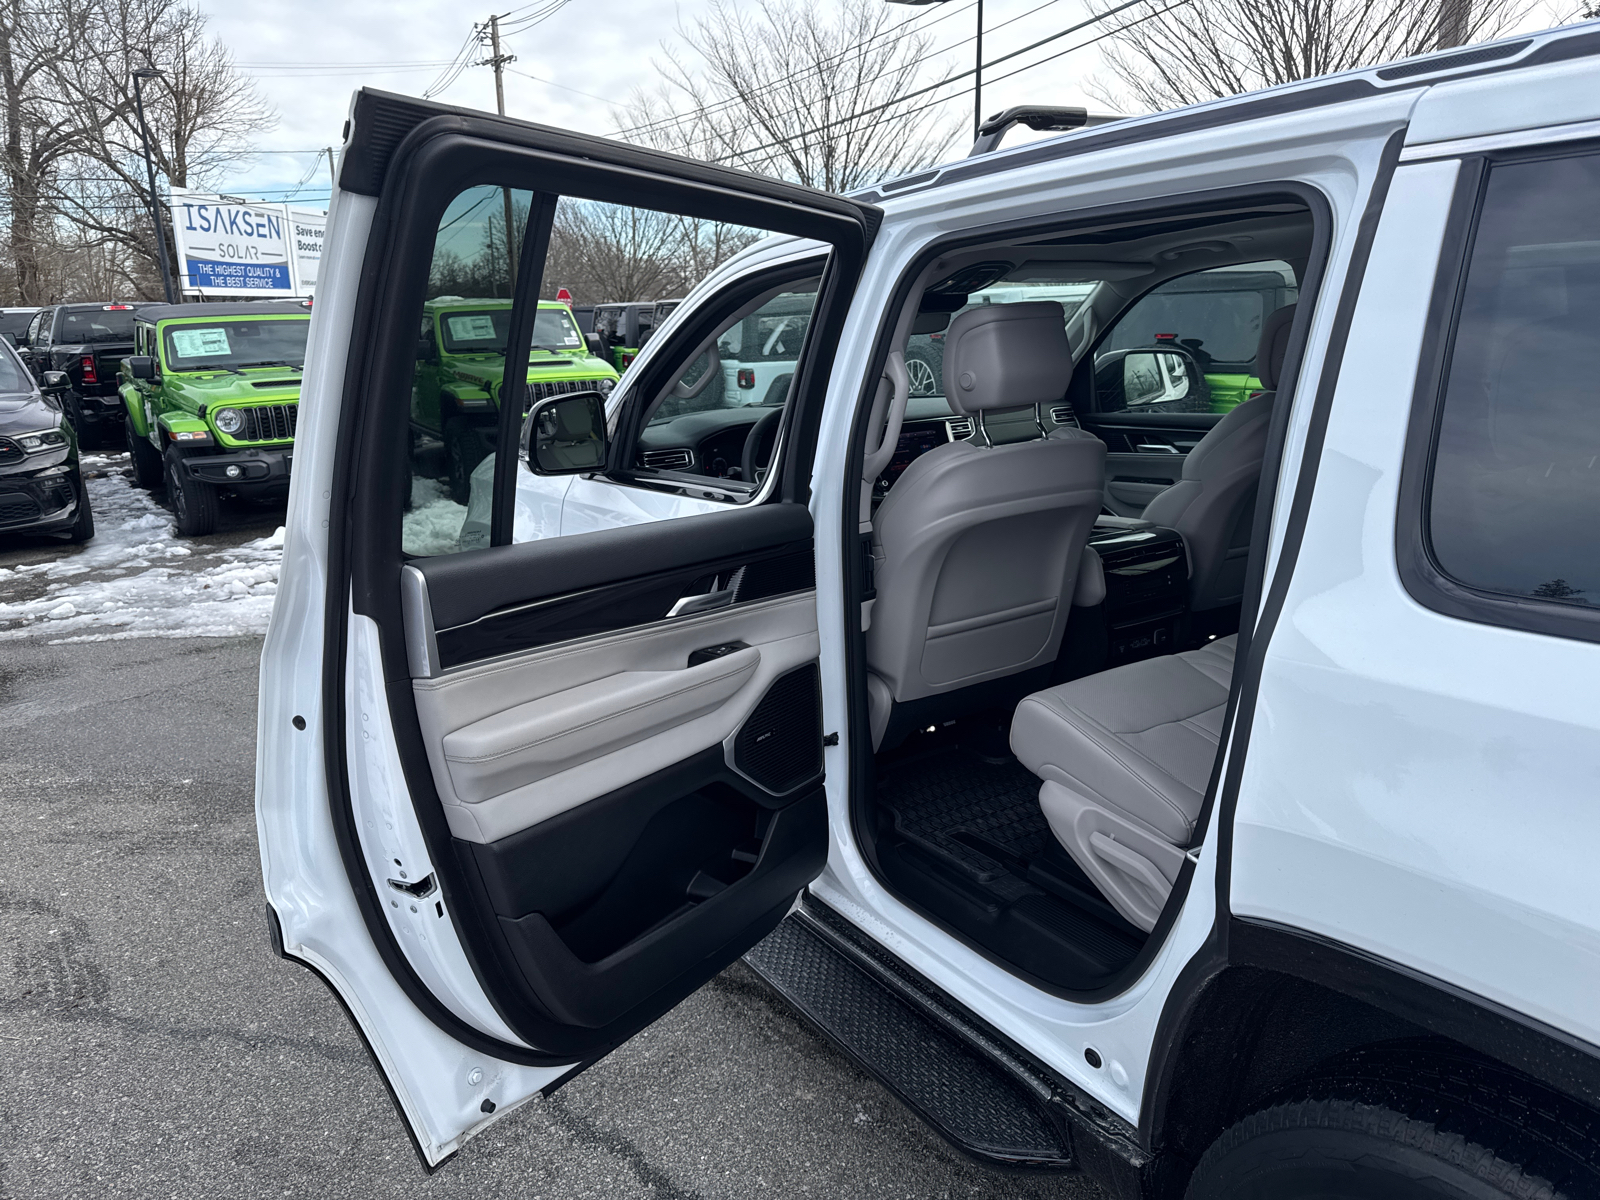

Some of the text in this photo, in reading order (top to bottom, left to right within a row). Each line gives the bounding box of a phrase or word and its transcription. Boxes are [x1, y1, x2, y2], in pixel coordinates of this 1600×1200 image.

[183, 203, 281, 240] ISAKSEN
[295, 225, 313, 237] Save
[218, 243, 259, 260] SOLAR
[297, 240, 318, 252] Boost
[198, 264, 281, 277] THE HIGHEST QUALITY &
[210, 276, 273, 288] THE BEST SERVICE
